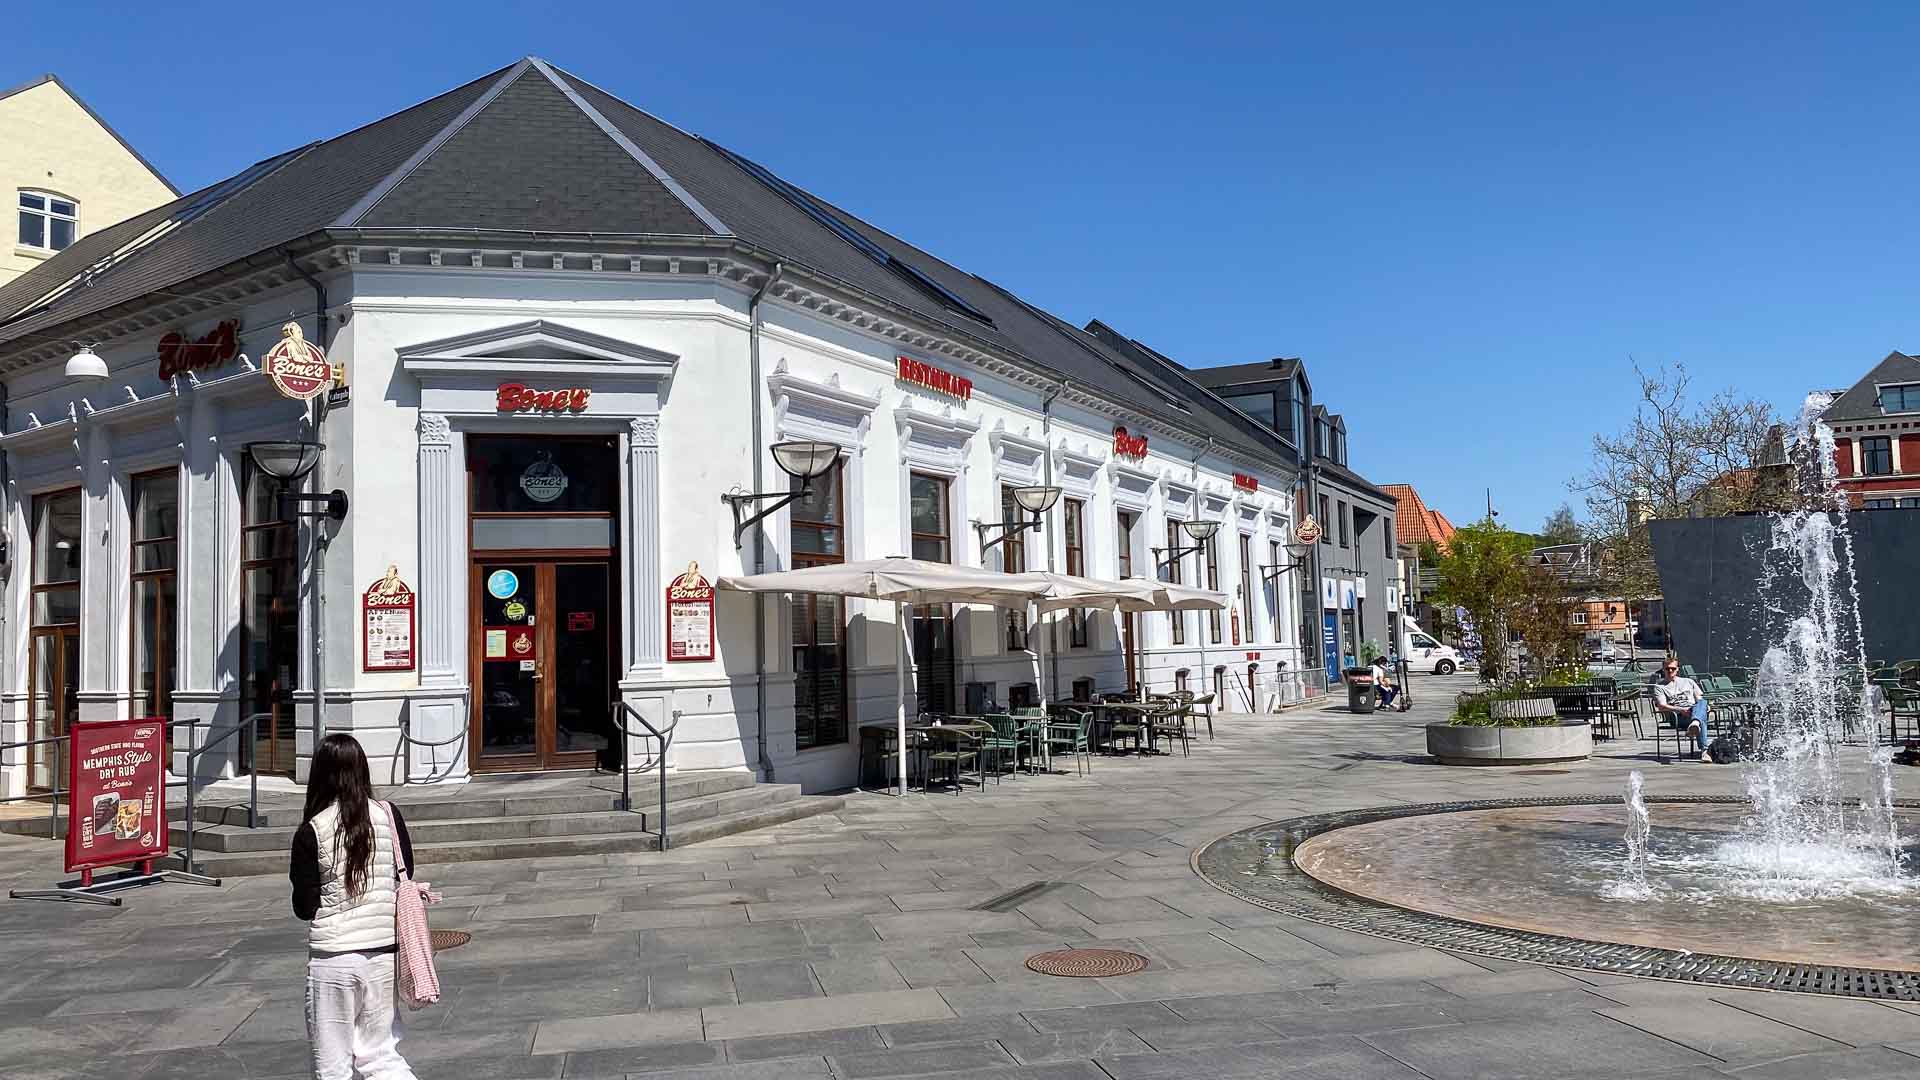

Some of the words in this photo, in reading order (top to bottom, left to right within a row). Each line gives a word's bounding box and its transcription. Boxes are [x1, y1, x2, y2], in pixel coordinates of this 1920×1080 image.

[273, 357, 326, 379] Bone's
[896, 356, 973, 400] RESTAURANT
[497, 383, 592, 411] Bone's
[367, 593, 411, 606] Bone's
[671, 586, 710, 599] Bone's
[83, 756, 122, 770] MEMPHIS
[124, 751, 152, 767] Style
[100, 768, 115, 779] DRY
[119, 766, 135, 777] RUB
